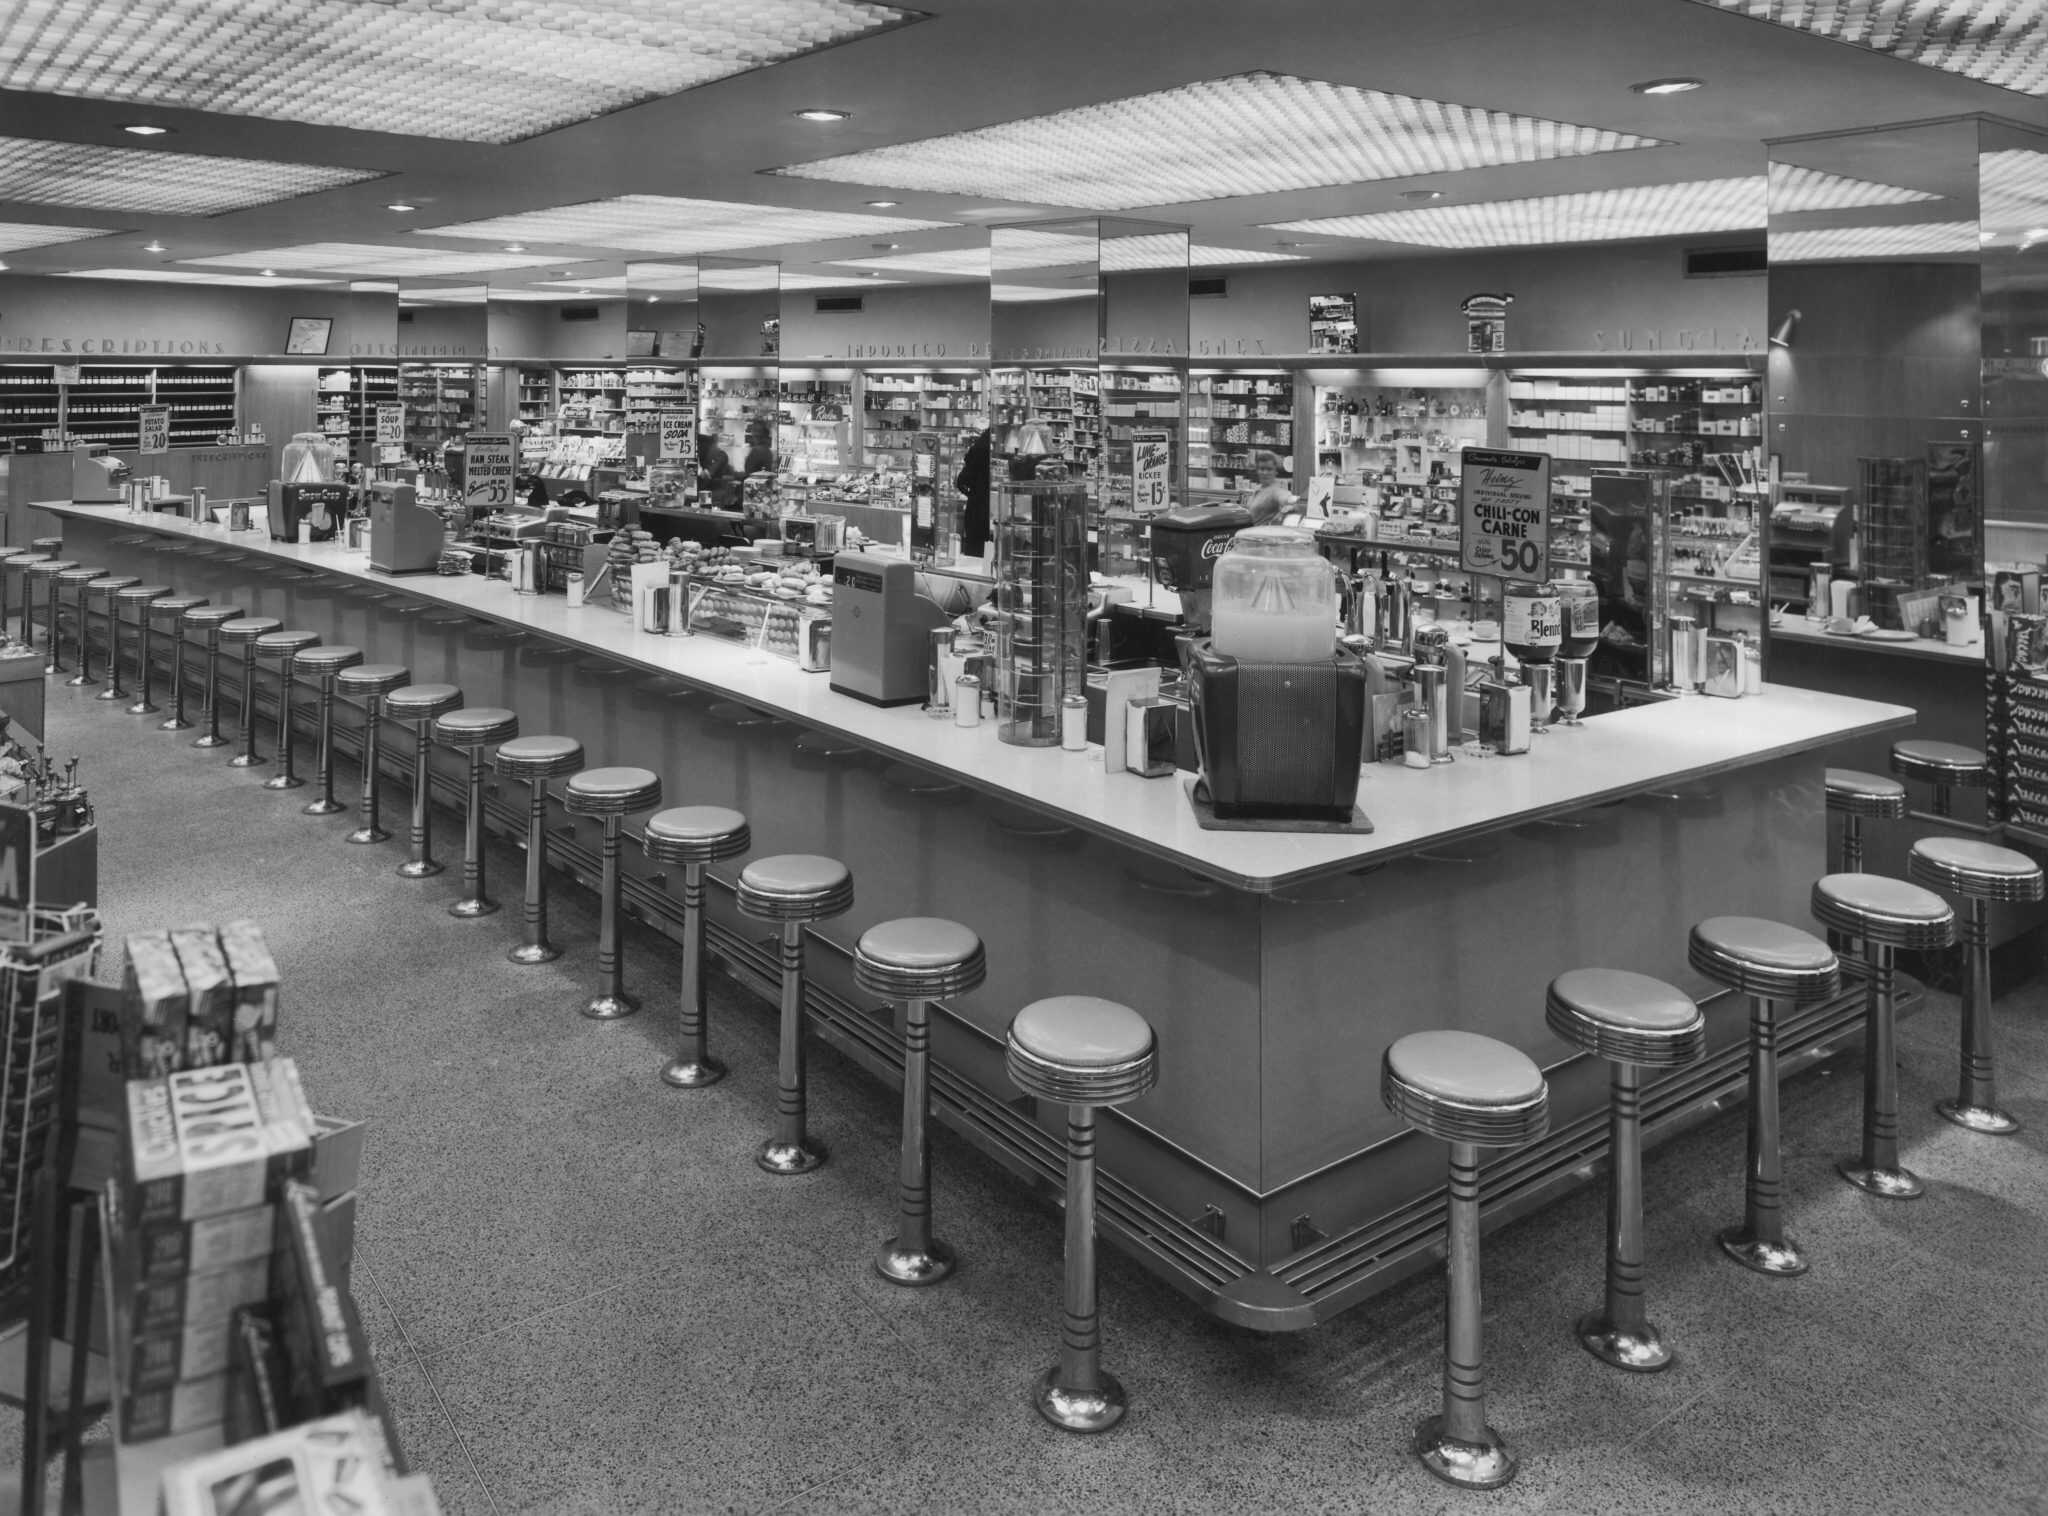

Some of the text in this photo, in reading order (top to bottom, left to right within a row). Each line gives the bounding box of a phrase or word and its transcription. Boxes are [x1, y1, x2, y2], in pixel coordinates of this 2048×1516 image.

[1594, 329, 1761, 352] SUNGLA
[381, 415, 399, 424] SOUP
[663, 420, 693, 429] ICE CREAM
[152, 433, 166, 449] 20
[664, 429, 689, 440] SODA
[470, 454, 510, 464] HAM STEAK
[468, 466, 491, 476] MELTED
[1473, 504, 1541, 525] CHILI-CON
[1480, 518, 1528, 539] CARNE
[175, 1068, 260, 1159] SPICE
